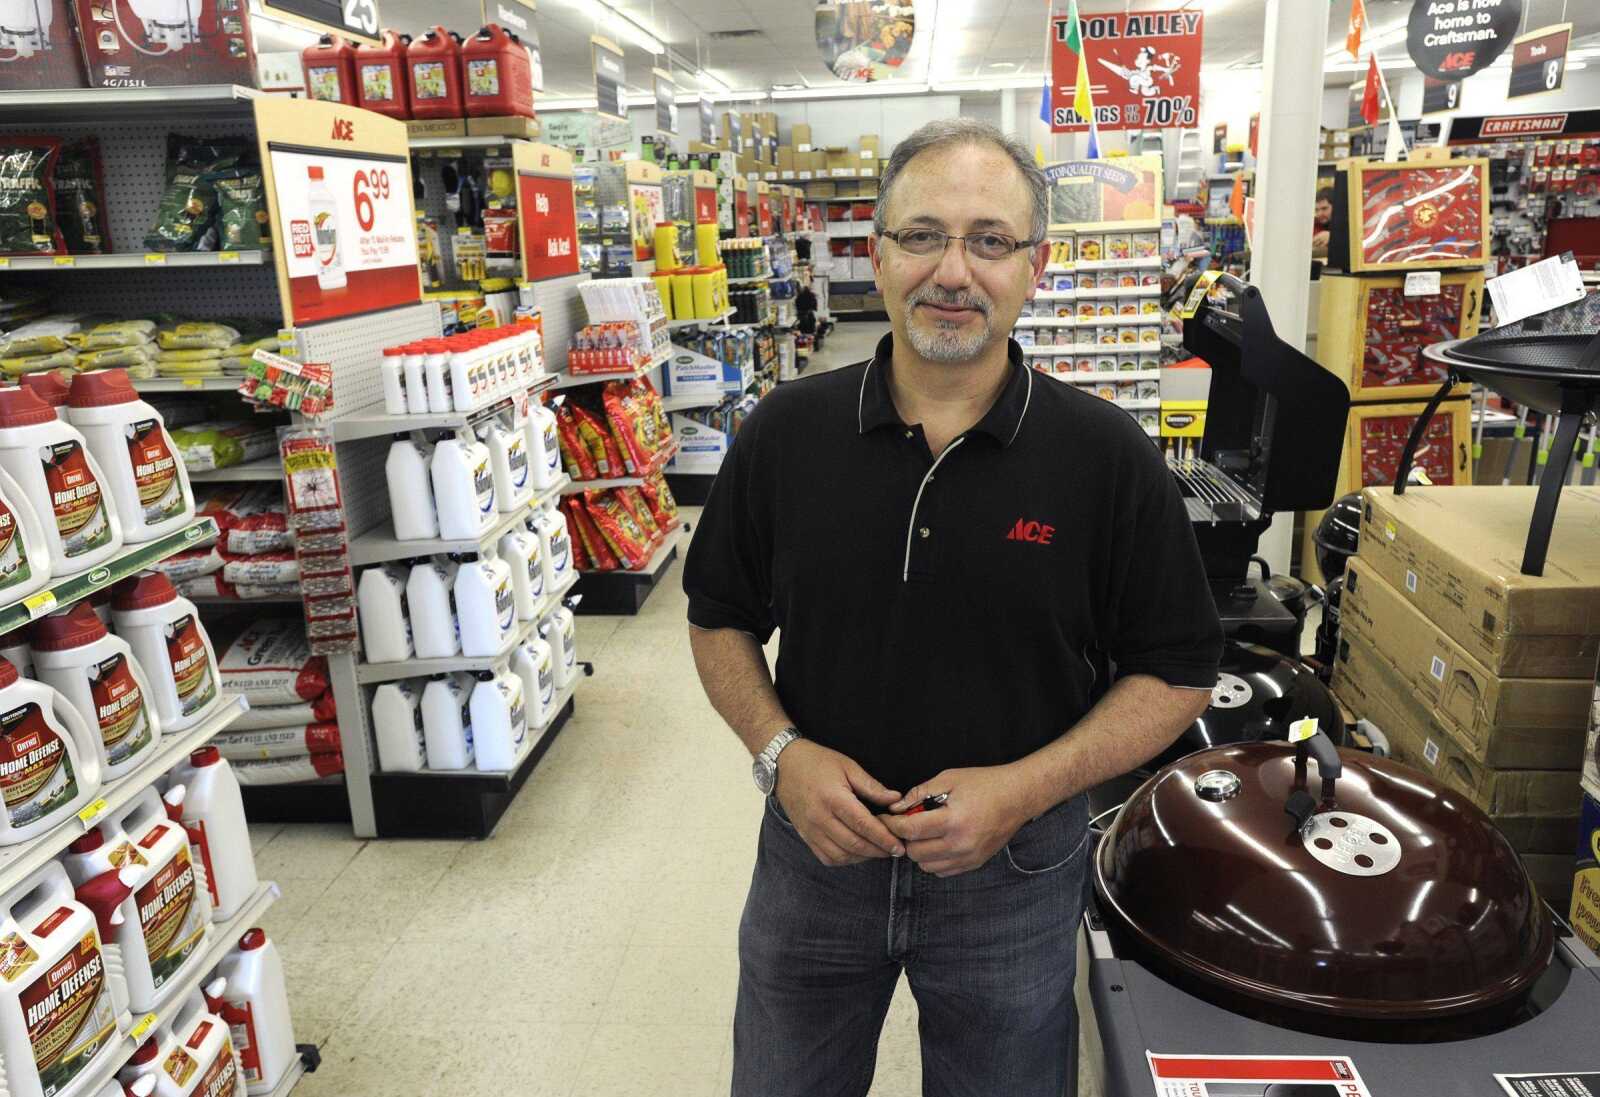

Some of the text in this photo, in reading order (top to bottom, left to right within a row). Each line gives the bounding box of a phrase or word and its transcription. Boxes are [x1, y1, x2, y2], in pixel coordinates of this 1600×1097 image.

[1427, 1, 1456, 16] Ace
[1458, 0, 1470, 10] is
[1124, 13, 1199, 37] ALLEY
[1434, 12, 1491, 31] home to
[1424, 28, 1498, 47] Craftsman.
[1439, 51, 1476, 70] ACE
[1545, 60, 1559, 89] 8
[1446, 84, 1457, 108] 9
[1055, 106, 1119, 125] SAVGS
[1144, 98, 1194, 125] 70%
[331, 116, 354, 141] ACE
[1485, 118, 1560, 133] CRAFTSMAN
[54, 488, 77, 505] HOME
[1008, 518, 1056, 544] ACE
[100, 699, 121, 719] HOME
[0, 737, 60, 777] HOME DEFENSE
[140, 866, 194, 924] HOME DEFENSE
[51, 960, 73, 983] ORTHO
[27, 953, 102, 1027] HOME DEFENSE
[57, 990, 85, 1017] MAX
